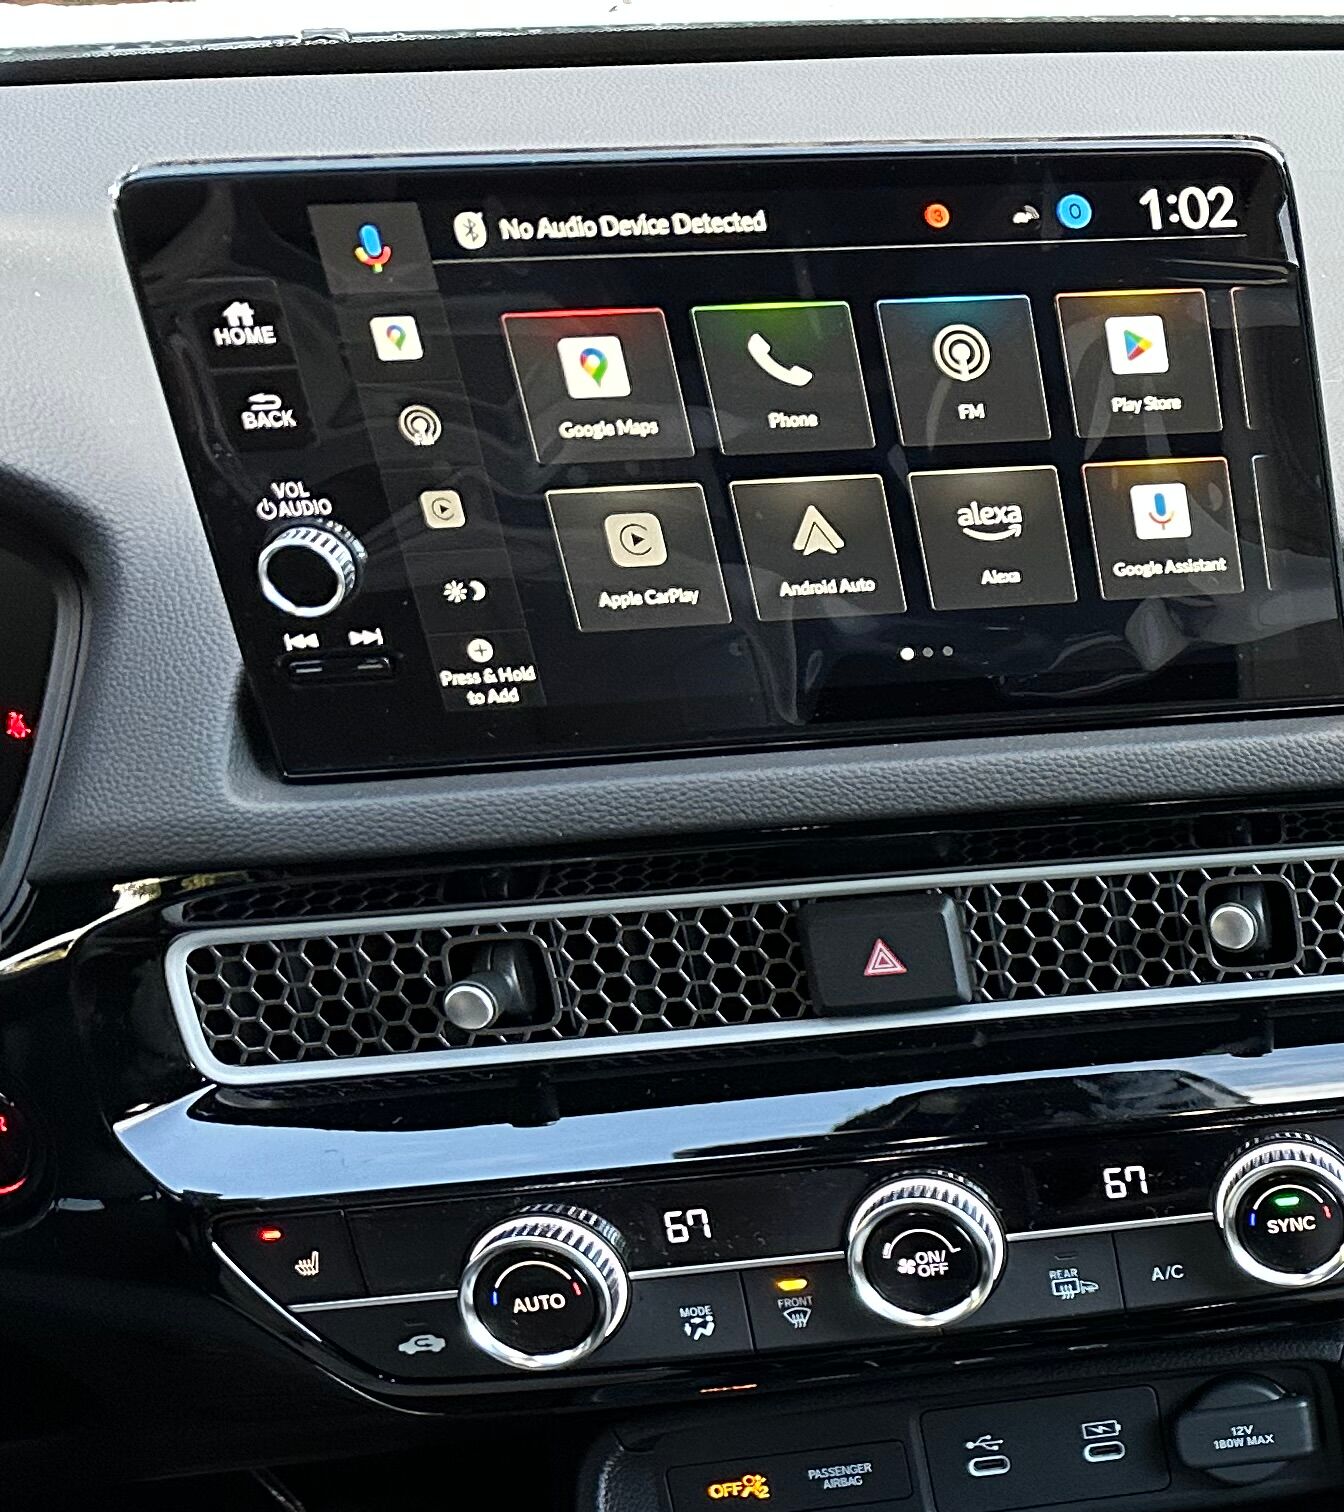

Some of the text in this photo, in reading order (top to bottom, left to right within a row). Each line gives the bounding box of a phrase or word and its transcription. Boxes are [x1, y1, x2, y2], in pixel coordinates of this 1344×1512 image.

[1139, 185, 1238, 230] 1:02
[499, 209, 768, 240] No Audio Device Detected
[213, 326, 277, 346] HOME
[958, 403, 985, 422] FM
[1112, 395, 1182, 414] Play Store
[241, 409, 297, 430] BACK
[558, 418, 658, 440] Google Maps
[767, 412, 818, 430] Phone
[270, 480, 310, 499] VOL
[278, 498, 333, 518] AUDIO
[957, 500, 1023, 527] alexa
[981, 569, 1021, 586] Alexa
[1113, 557, 1227, 579] Google Assistant
[779, 577, 875, 598] Android Auto
[599, 588, 699, 609] Apple CarPlay
[439, 665, 536, 687] Press & Hold
[467, 687, 520, 706] to Add
[1103, 1166, 1148, 1199] 67
[663, 1208, 712, 1244] 67
[1267, 1215, 1317, 1235] SYNC
[915, 1249, 946, 1265] ON/
[917, 1262, 949, 1278] OFF
[1049, 1268, 1079, 1280] REAR
[1152, 1264, 1184, 1282] A/C
[513, 1293, 566, 1314] AUTO
[679, 1305, 712, 1318] MODE
[777, 1295, 813, 1309] FRONT
[1231, 1425, 1254, 1436] 12V
[1246, 1433, 1275, 1446] MAX
[808, 1462, 872, 1480] PASSENGER
[707, 1482, 742, 1499] OFF
[823, 1475, 863, 1490] AIRBAG
